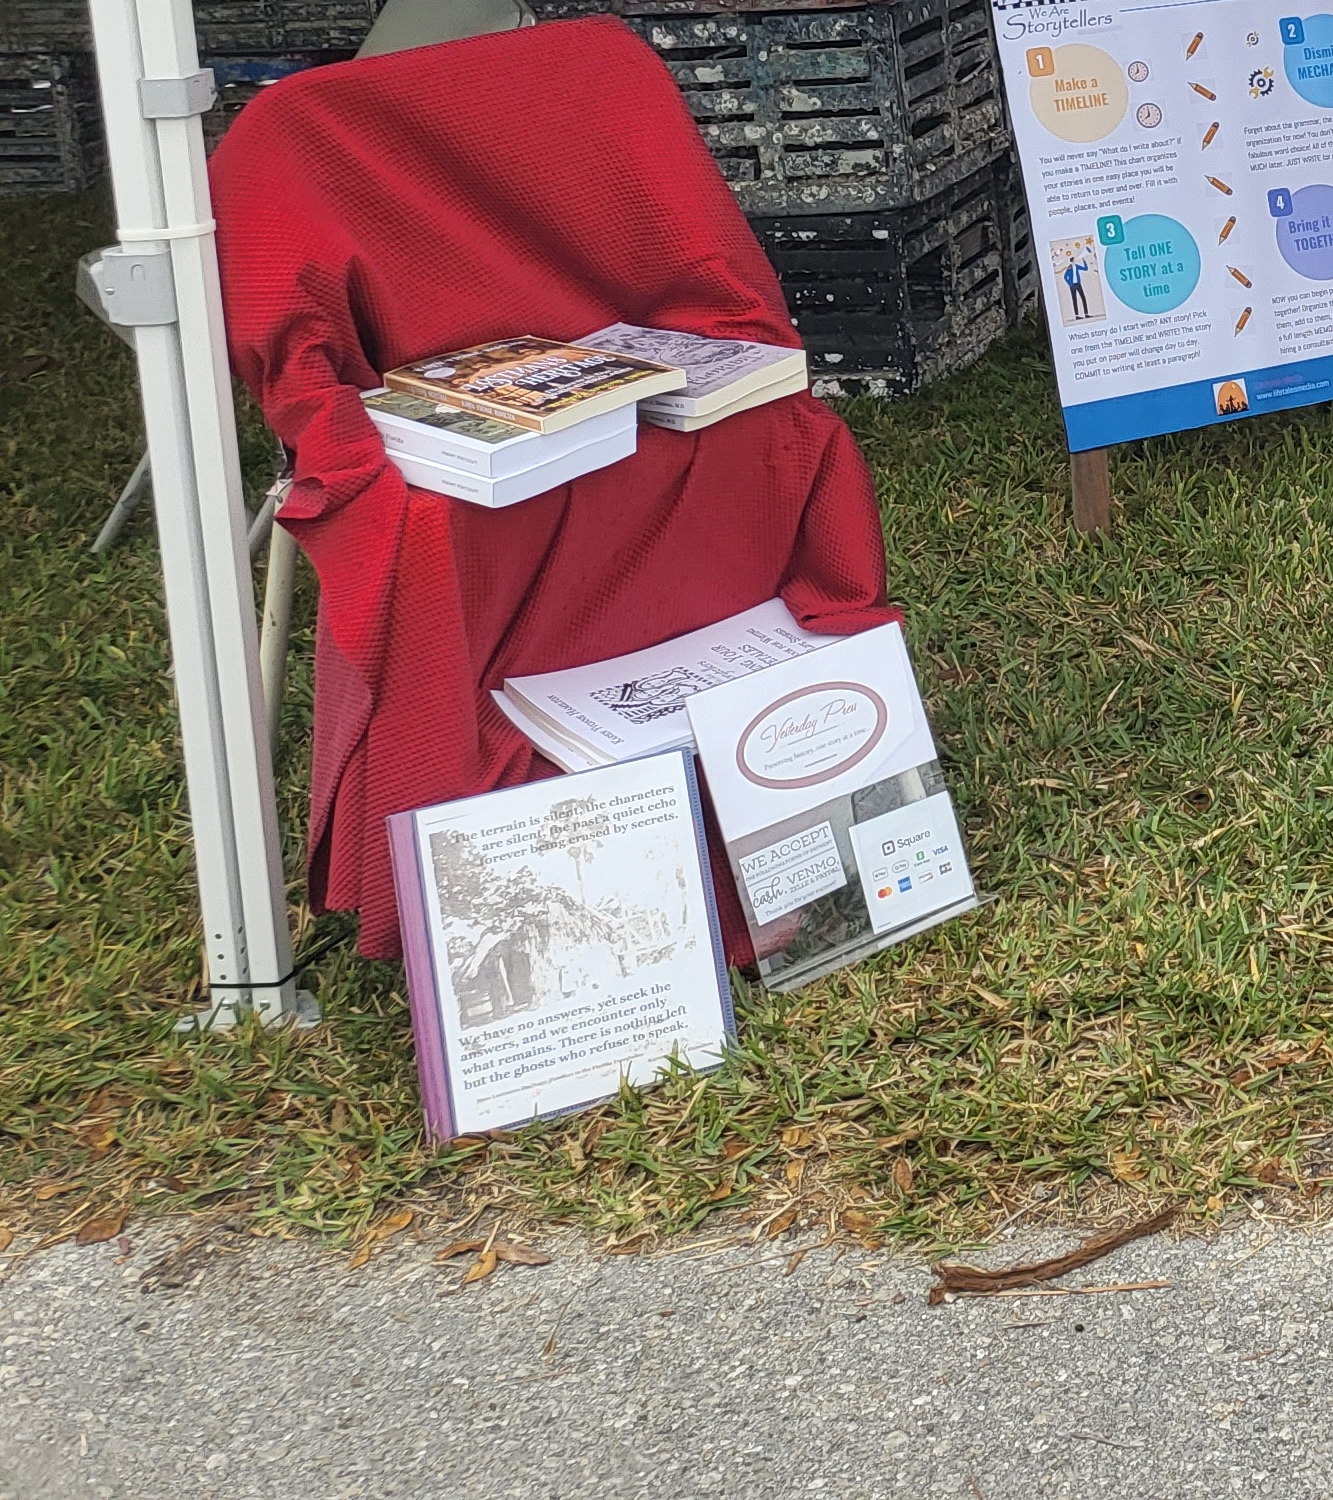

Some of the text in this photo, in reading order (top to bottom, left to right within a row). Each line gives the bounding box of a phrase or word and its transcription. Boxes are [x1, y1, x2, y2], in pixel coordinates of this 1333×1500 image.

[1028, 6, 1070, 18] We Are
[1002, 9, 1113, 41] Storytellers
[1287, 24, 1297, 38] 2
[1034, 55, 1045, 69] 1
[1054, 78, 1099, 93] Make a
[1054, 92, 1109, 113] TIMELINE
[1275, 196, 1284, 209] 4
[1105, 223, 1116, 238] 3
[1288, 217, 1319, 235] Bring
[1321, 215, 1331, 229] it
[1123, 242, 1173, 261] Tell ONE
[1119, 262, 1184, 281] STORY at a
[1142, 282, 1171, 298] time
[896, 830, 930, 849] Square
[741, 826, 828, 873] WE ACCEPT
